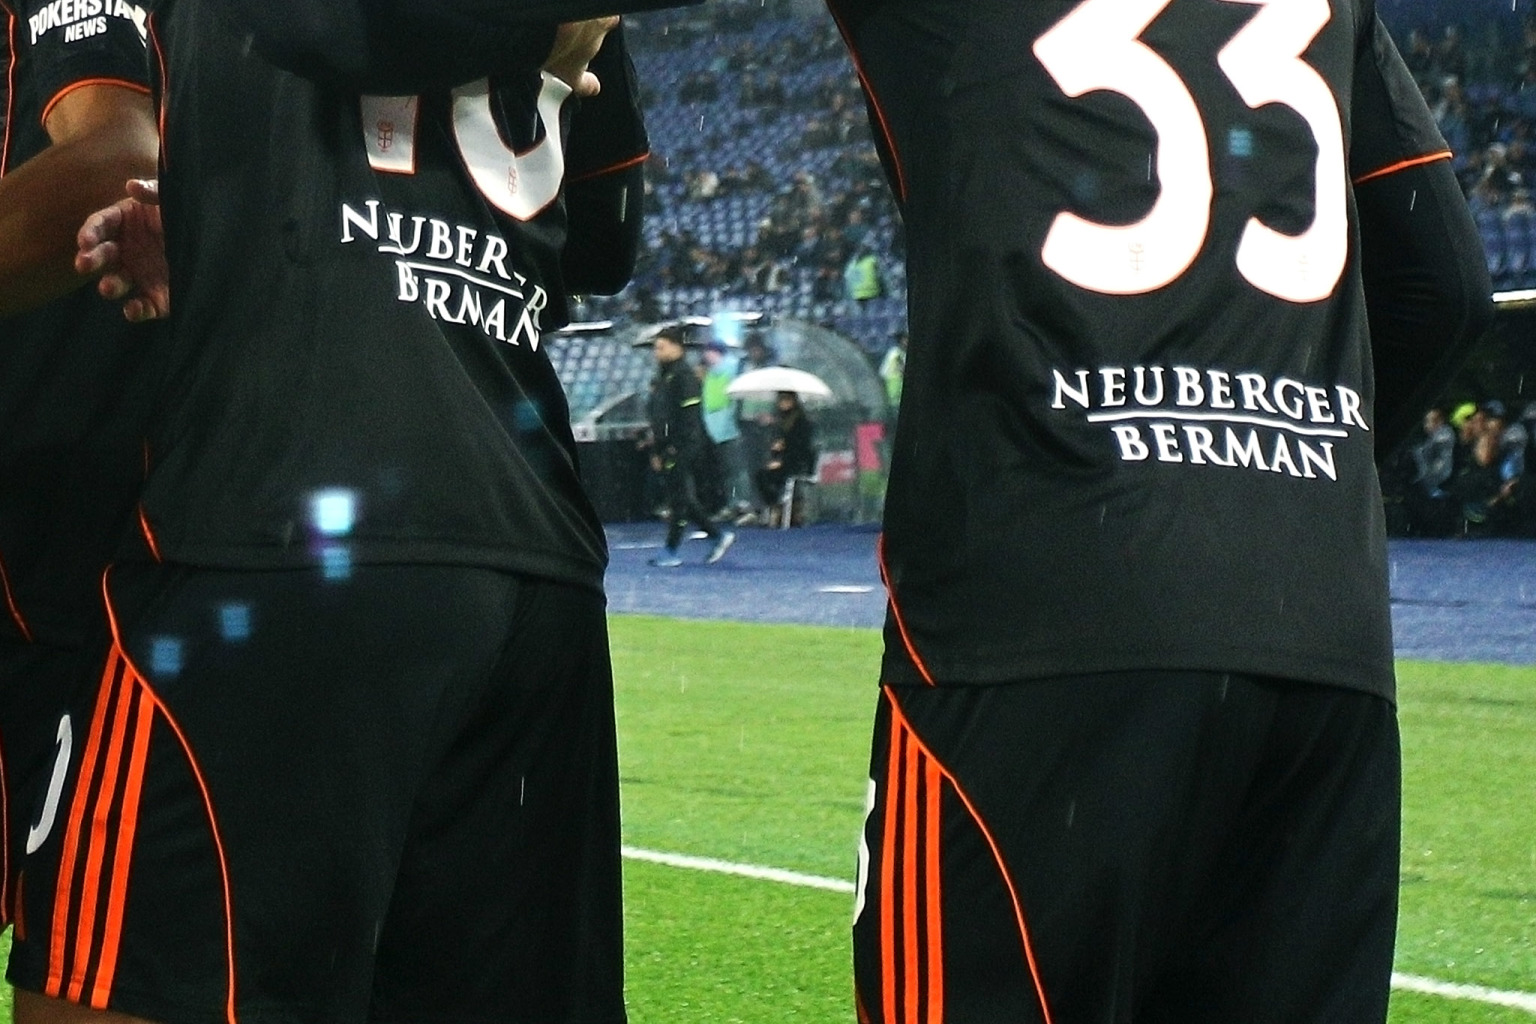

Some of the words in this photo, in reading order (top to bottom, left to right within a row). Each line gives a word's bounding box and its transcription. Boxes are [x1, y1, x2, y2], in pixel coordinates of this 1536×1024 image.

[64, 16, 107, 43] NEWS
[395, 259, 539, 352] BRMAN
[1051, 365, 1369, 431] NEUBERGER
[1111, 424, 1337, 482] BERMAN
